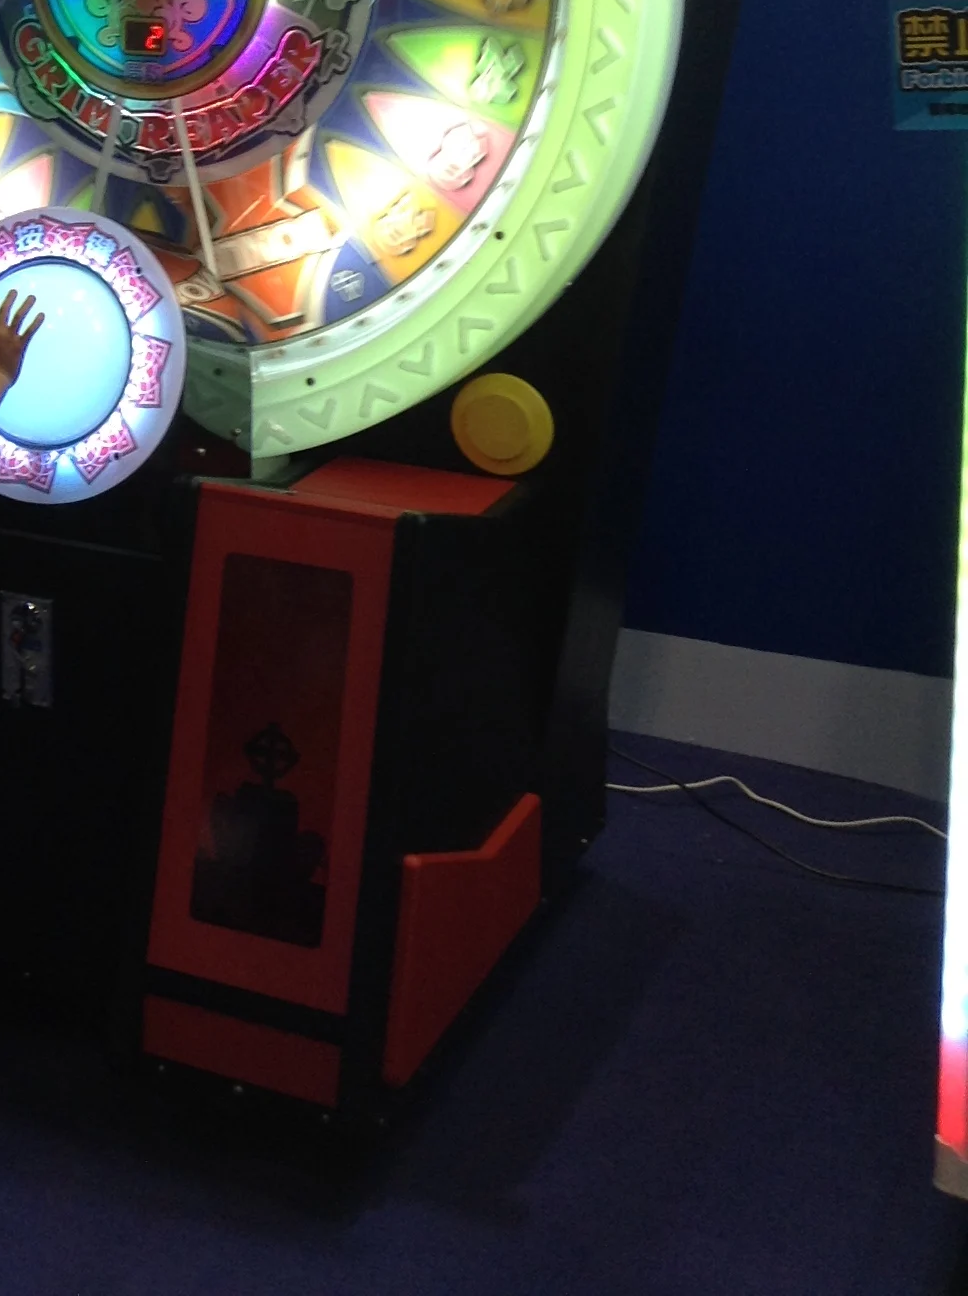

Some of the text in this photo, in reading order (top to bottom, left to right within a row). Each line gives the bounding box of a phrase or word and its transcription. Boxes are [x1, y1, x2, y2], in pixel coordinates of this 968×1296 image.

[145, 25, 163, 49] 2
[14, 20, 119, 136] GRIM
[139, 27, 323, 153] REAPER
